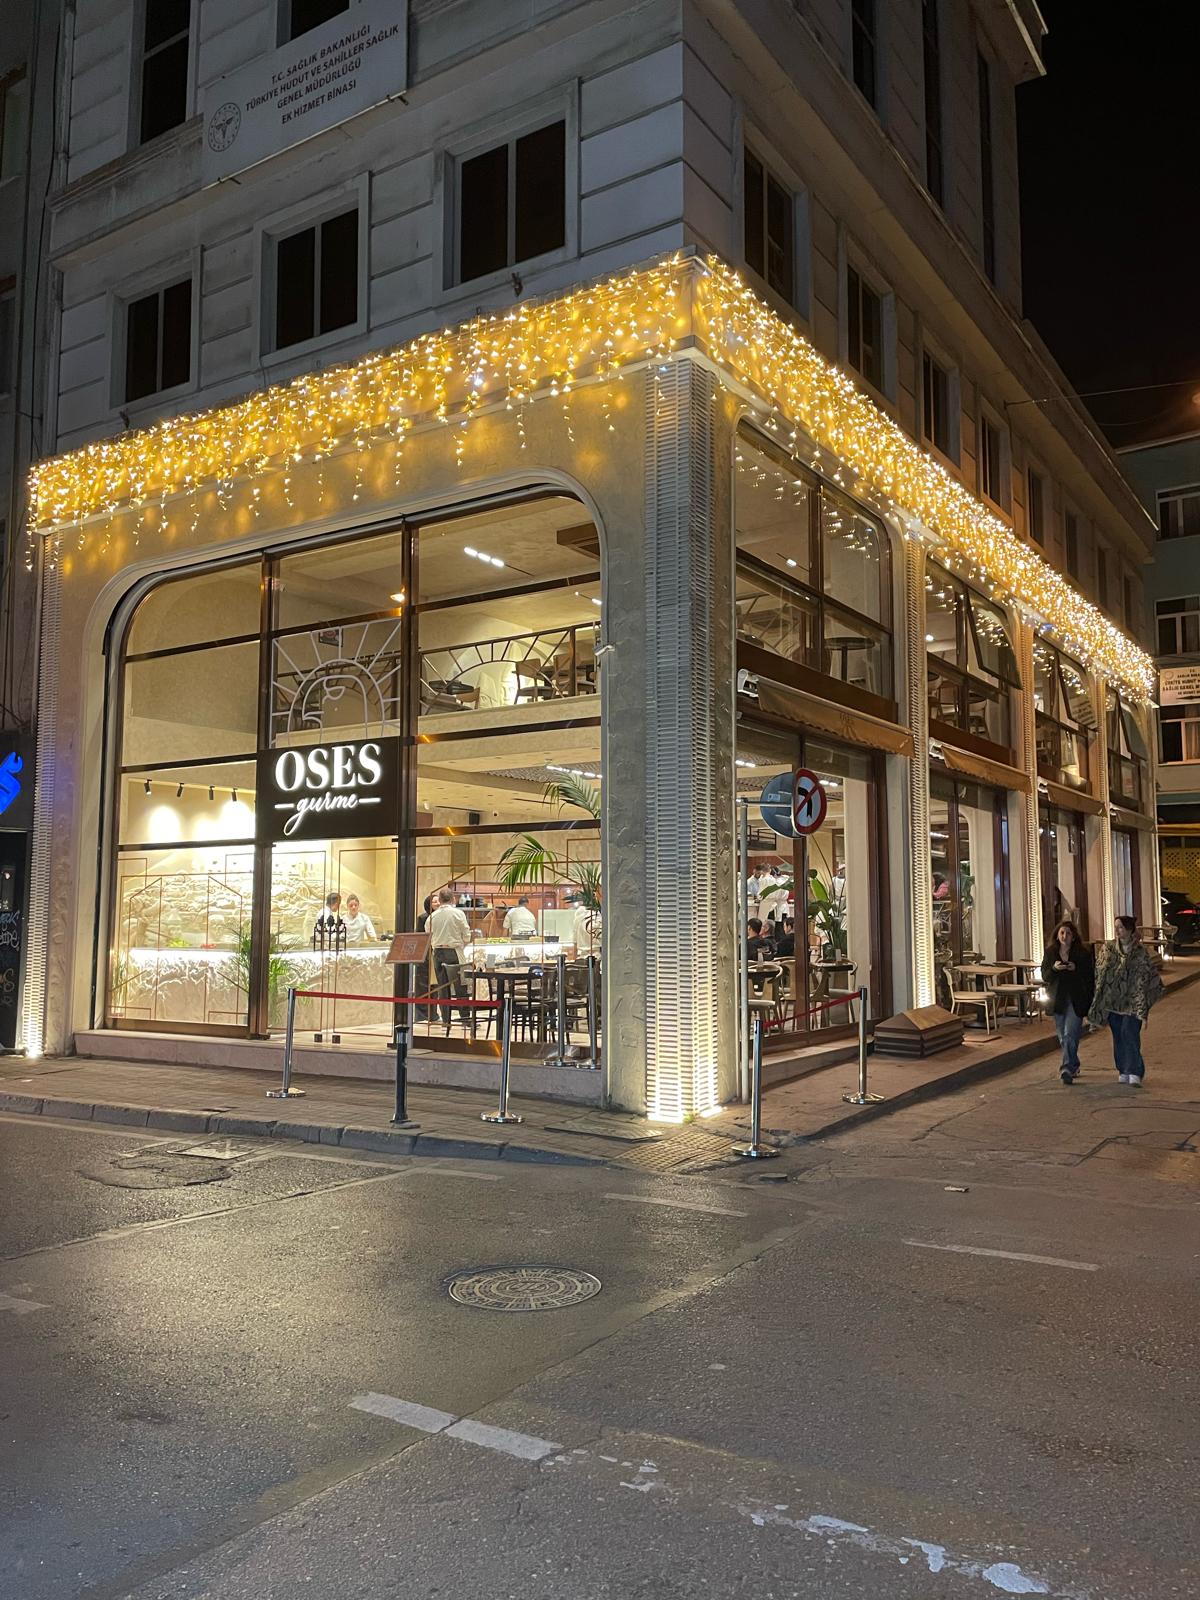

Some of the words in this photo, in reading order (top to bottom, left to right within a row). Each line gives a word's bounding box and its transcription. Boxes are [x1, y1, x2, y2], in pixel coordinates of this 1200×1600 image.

[271, 71, 285, 85] T.C.
[287, 52, 318, 75] SAĞLIK
[319, 24, 371, 59] BAKANLIĞI
[280, 71, 310, 94] HUDUT
[310, 65, 322, 78] VE
[323, 42, 365, 72] SAHİLLER
[365, 23, 399, 49] SAĞLIK
[277, 91, 303, 109] GENEL
[304, 57, 362, 94] MÜDÜRLÜĞÜ
[281, 109, 293, 124] EK
[275, 743, 382, 792] OSES
[283, 791, 358, 836] gurme
